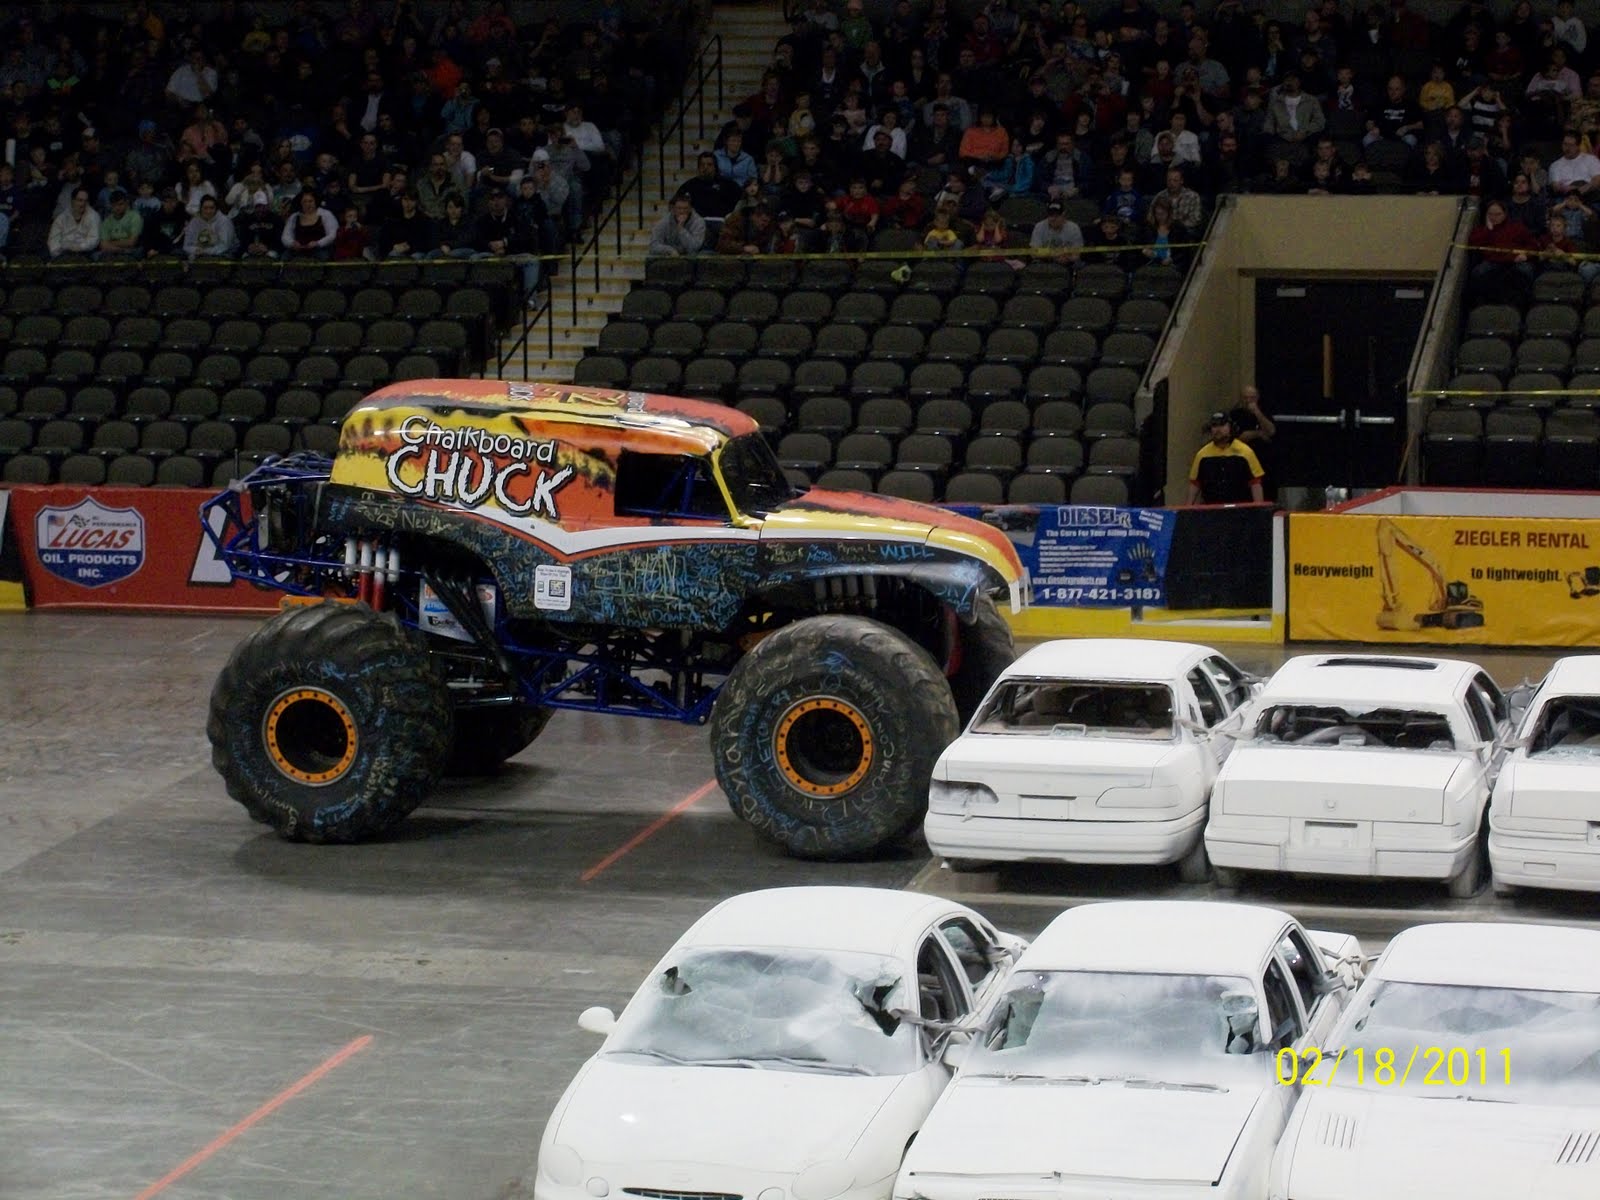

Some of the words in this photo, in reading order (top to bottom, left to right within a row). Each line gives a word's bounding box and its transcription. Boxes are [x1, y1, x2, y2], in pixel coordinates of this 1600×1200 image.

[401, 415, 555, 463] Chalkboard
[386, 445, 574, 518] CHUCK
[48, 528, 135, 549] LUCAS
[1454, 530, 1521, 548] ZIEGLER
[1527, 531, 1590, 549] RENTAL
[42, 553, 65, 564] OIL
[68, 553, 137, 566] PRODUCTS
[879, 544, 935, 561] WILL
[78, 568, 104, 578] INC.
[1293, 563, 1374, 579] Heavyweight
[1471, 567, 1483, 579] to
[1043, 588, 1161, 600] 1-877-421-3187
